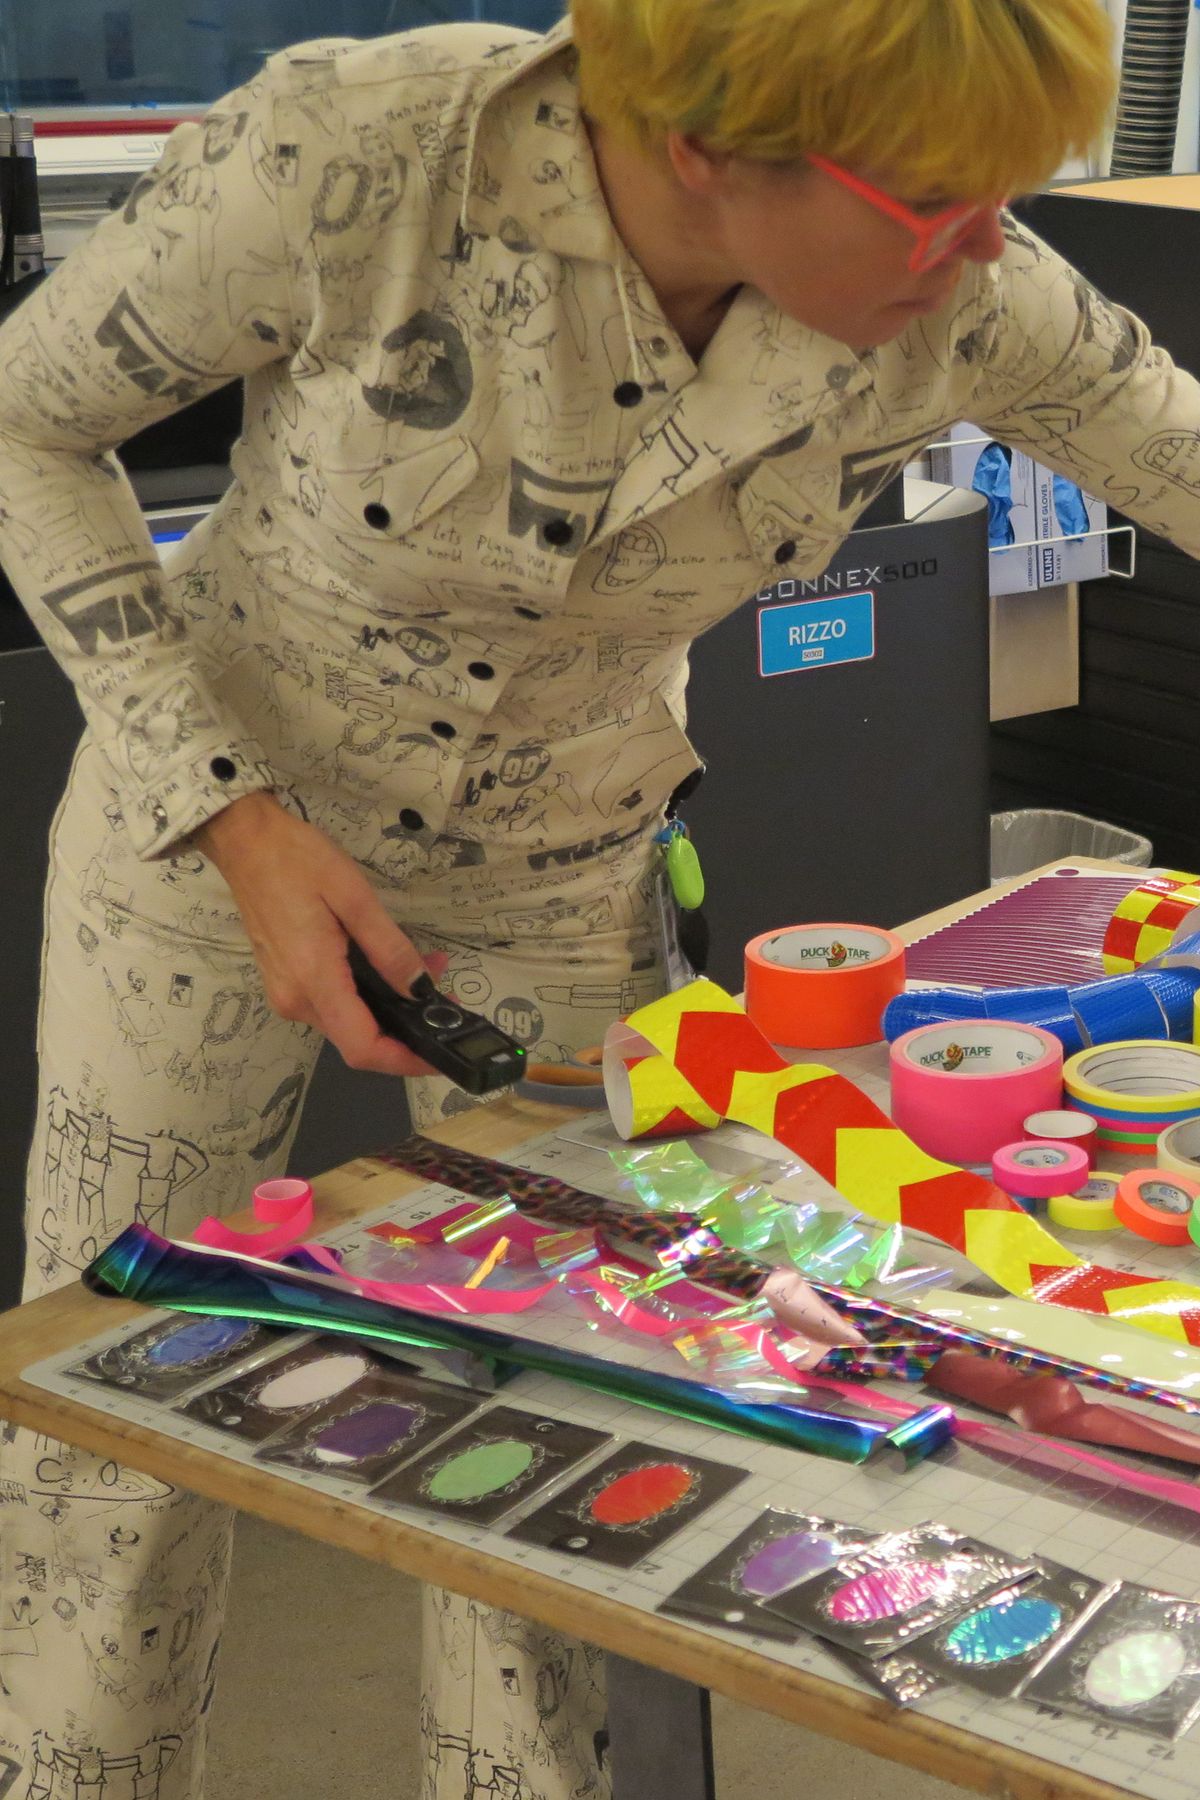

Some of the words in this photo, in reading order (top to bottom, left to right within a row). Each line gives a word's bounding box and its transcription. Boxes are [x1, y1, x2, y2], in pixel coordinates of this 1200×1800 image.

[1041, 483, 1049, 514] GLOVES
[1044, 549, 1054, 581] ULINE
[788, 618, 846, 647] RIZZO
[800, 946, 830, 959] DUCK
[848, 947, 871, 960] TAPE
[919, 1051, 945, 1065] DUCK
[962, 1046, 992, 1057] TAPE
[409, 1210, 432, 1221] 15
[144, 1501, 165, 1514] the
[1146, 1742, 1176, 1761] 12
